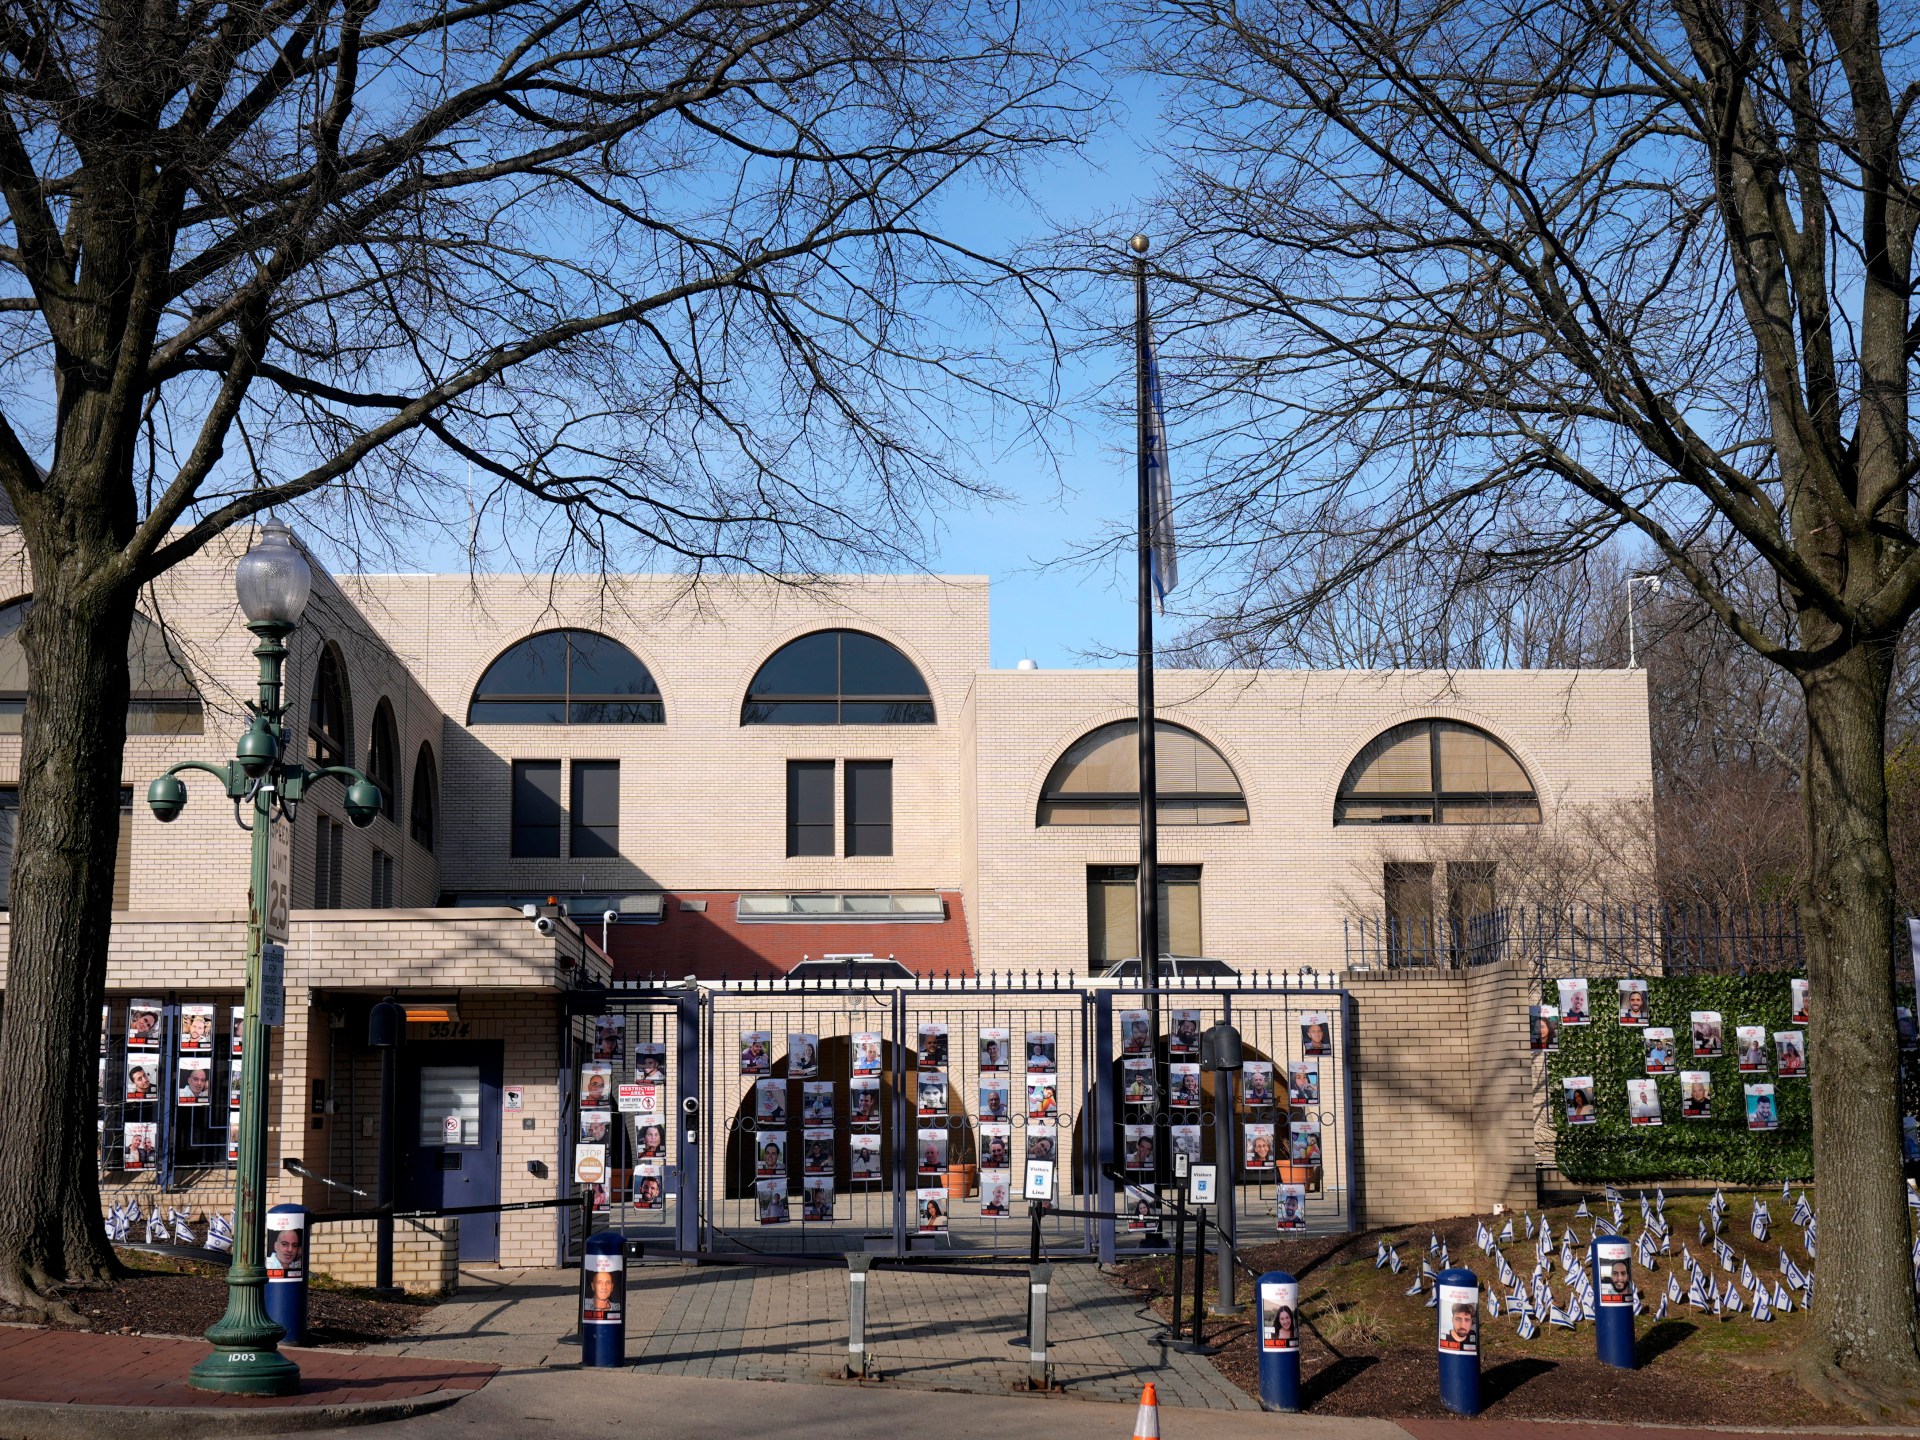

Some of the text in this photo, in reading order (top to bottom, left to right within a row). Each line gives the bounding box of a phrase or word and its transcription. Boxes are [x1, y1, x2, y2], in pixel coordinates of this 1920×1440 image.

[270, 823, 289, 846] SPEED
[272, 849, 287, 875] LIMIT
[269, 879, 287, 930] 25
[263, 952, 284, 963] RESERVED
[268, 964, 278, 973] FOR
[264, 985, 279, 995] ISRAEL
[263, 996, 280, 1006] VEHICLE
[266, 1007, 277, 1018] ONLY
[429, 1022, 471, 1038] 3514
[580, 1149, 602, 1157] STOP
[228, 1353, 256, 1362] ID03
